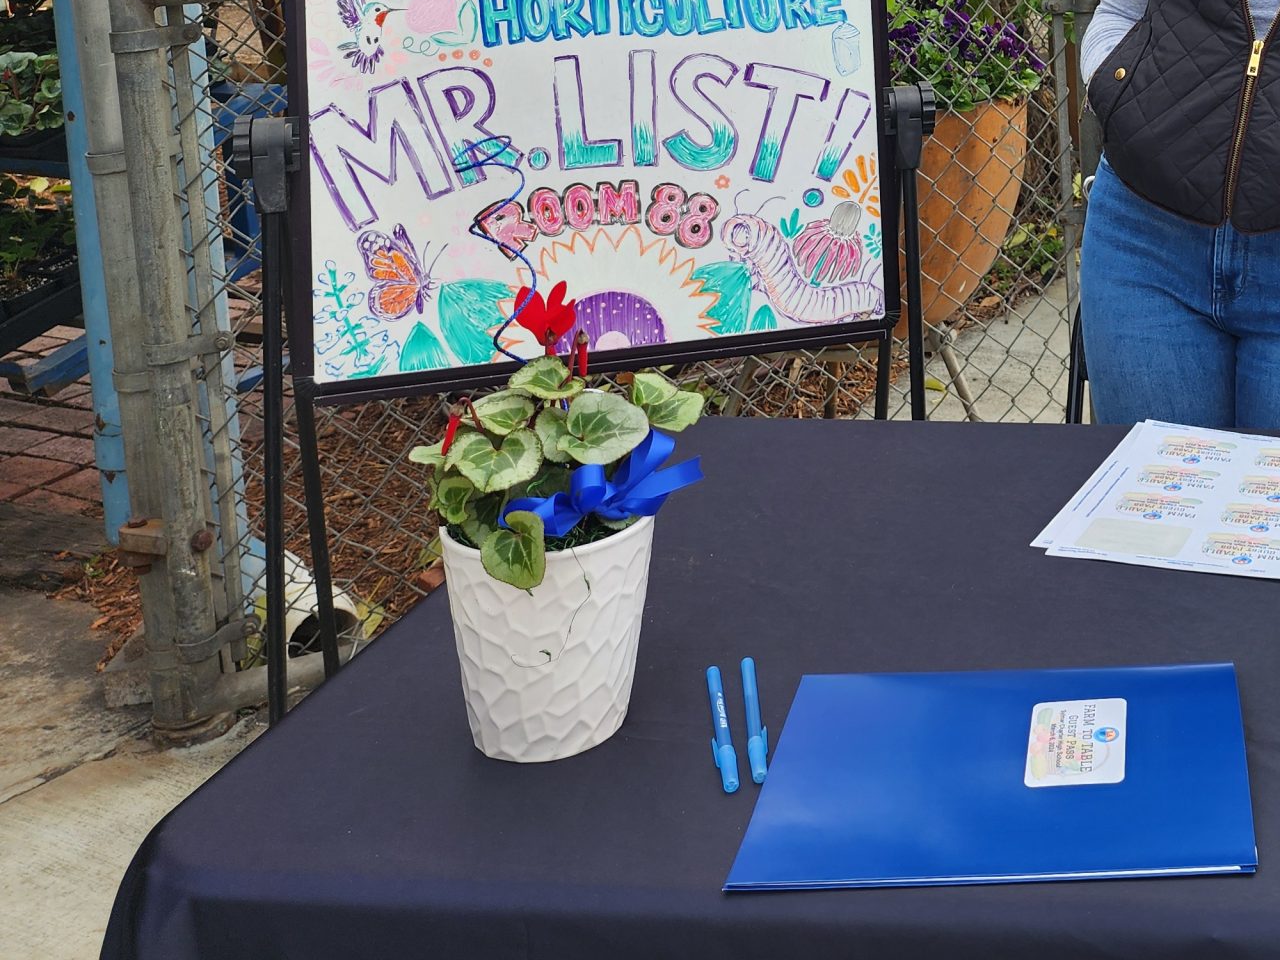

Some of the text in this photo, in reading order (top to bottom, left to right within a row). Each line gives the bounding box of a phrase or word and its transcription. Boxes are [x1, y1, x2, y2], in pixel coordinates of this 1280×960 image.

[554, 48, 871, 209] LIST!
[473, 179, 721, 261] ROOM 88
[1066, 715, 1079, 760] GUEST PASS
[1080, 704, 1096, 772] FARM TO TABLE
